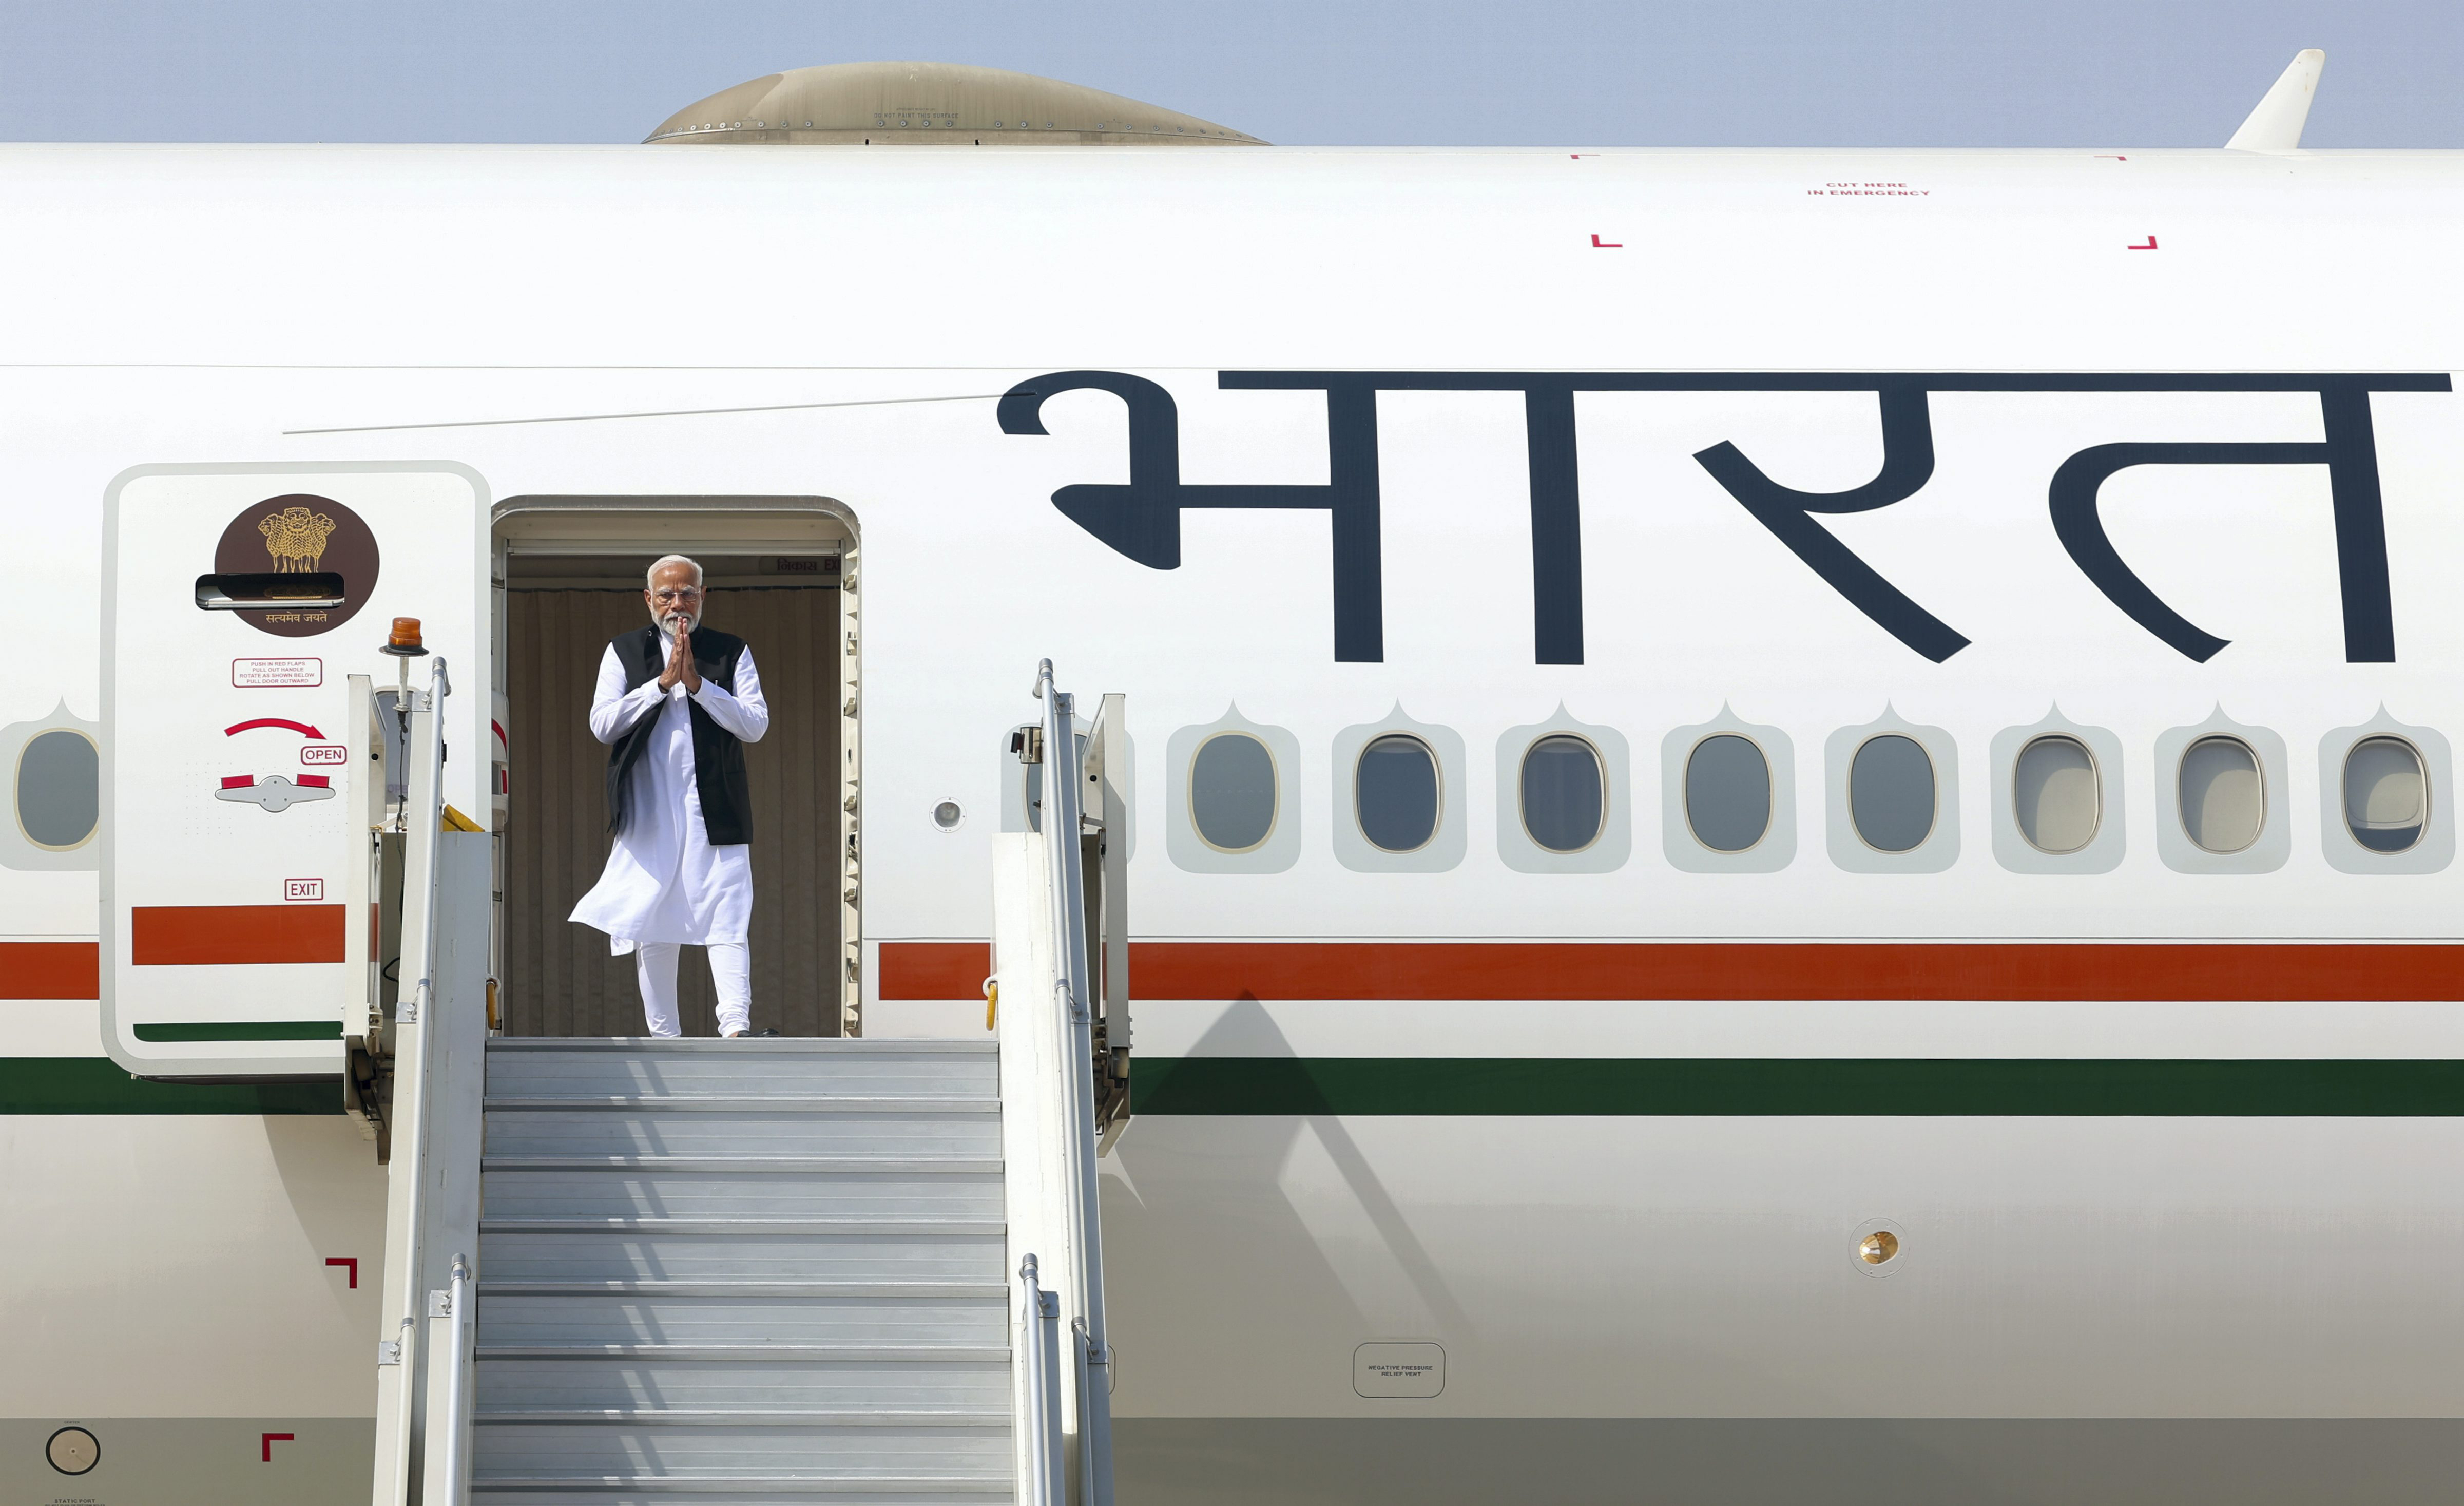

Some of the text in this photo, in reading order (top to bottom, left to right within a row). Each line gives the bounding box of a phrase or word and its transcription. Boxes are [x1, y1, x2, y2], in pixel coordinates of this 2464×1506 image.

[997, 370, 2452, 665] भारत
[777, 558, 841, 571] निकास EXI
[266, 610, 327, 623] सत्यमेव जयते
[305, 750, 341, 760] OPEN
[387, 784, 408, 794] OPE
[291, 883, 317, 895] EXIT
